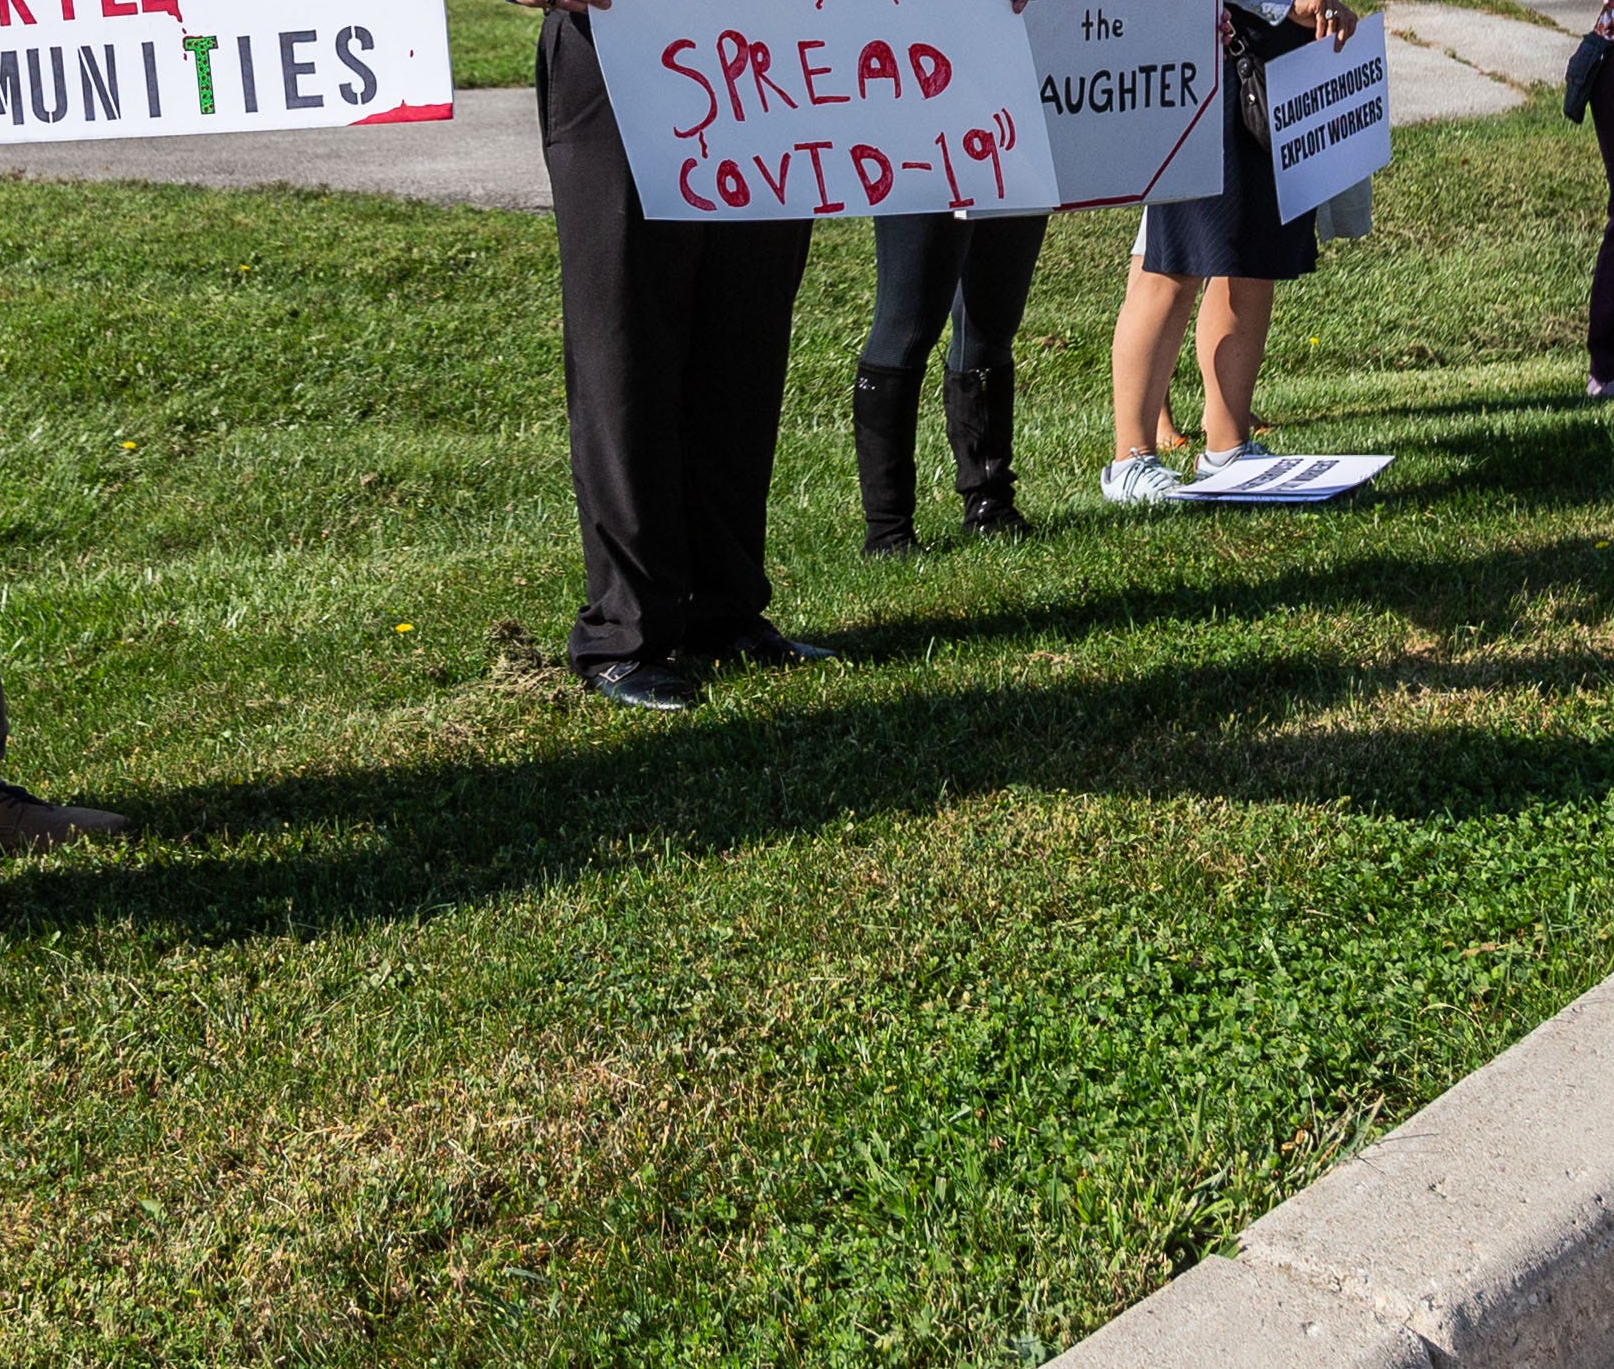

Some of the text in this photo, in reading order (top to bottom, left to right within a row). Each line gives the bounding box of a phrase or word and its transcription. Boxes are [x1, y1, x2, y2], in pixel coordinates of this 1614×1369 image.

[1081, 9, 1124, 42] the
[661, 30, 952, 145] SPREAD
[1040, 62, 1198, 115] AUGHTER
[1273, 56, 1383, 132] SLAUGHTERHOUSES
[1280, 96, 1383, 170] EXPLOIT WORKERS
